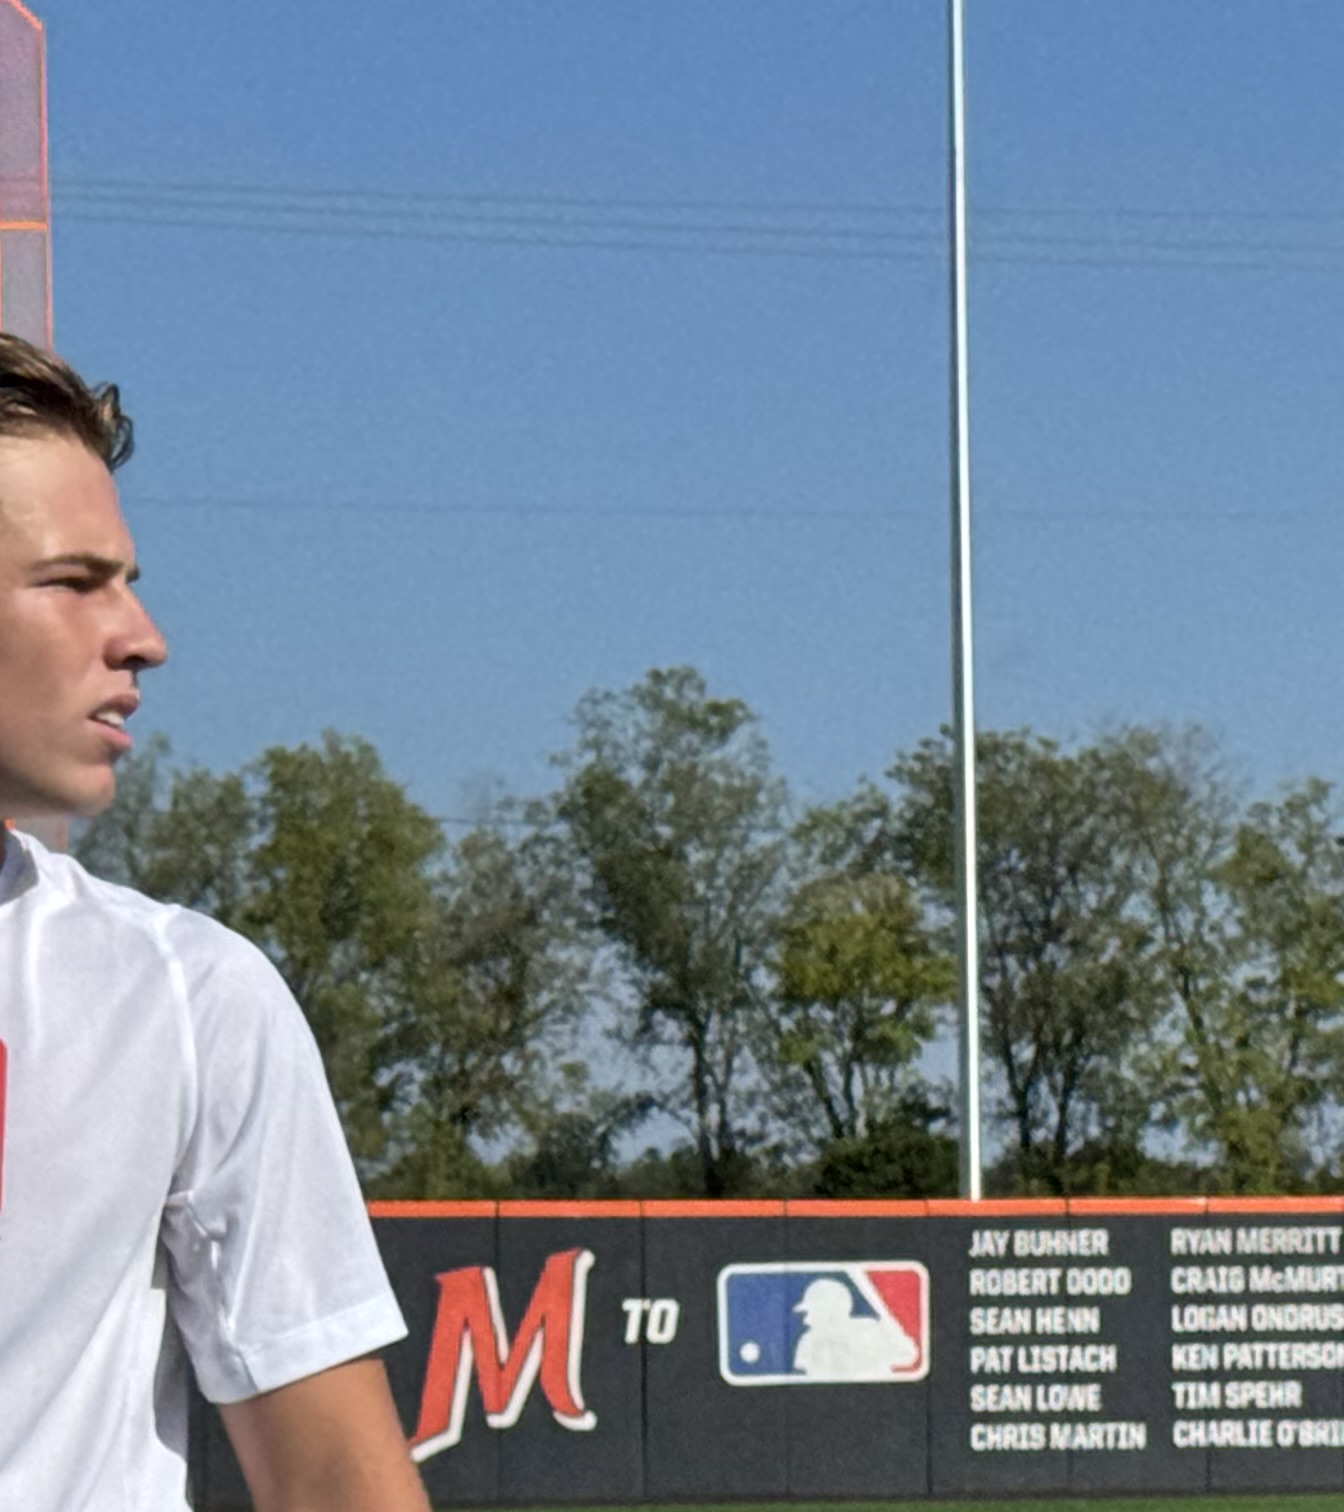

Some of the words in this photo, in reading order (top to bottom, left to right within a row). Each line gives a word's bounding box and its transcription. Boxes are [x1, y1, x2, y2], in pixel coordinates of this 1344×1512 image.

[968, 1229, 1009, 1257] JAY
[1013, 1228, 1109, 1256] BUHNER
[1170, 1227, 1232, 1255] RYAN
[1235, 1226, 1343, 1254] MERRITT
[969, 1267, 1062, 1295] ROBERT
[1170, 1265, 1246, 1294] CRAIG
[969, 1306, 1032, 1335] SEAN
[1035, 1305, 1101, 1334] HENN
[1171, 1304, 1248, 1332] LOGAN
[408, 1247, 597, 1463] M
[621, 1298, 680, 1344] TO
[969, 1345, 1015, 1373] PAT
[1017, 1344, 1118, 1373] LISTACH
[1171, 1342, 1220, 1371] KEN
[969, 1383, 1033, 1412] SEAN
[1035, 1383, 1102, 1412] LOWE
[1171, 1381, 1222, 1409] TIM
[1224, 1379, 1303, 1409] SPEHR
[970, 1422, 1047, 1450] CHRIS
[1049, 1421, 1147, 1450] MARTIN
[1172, 1418, 1274, 1448] CHARLIE
